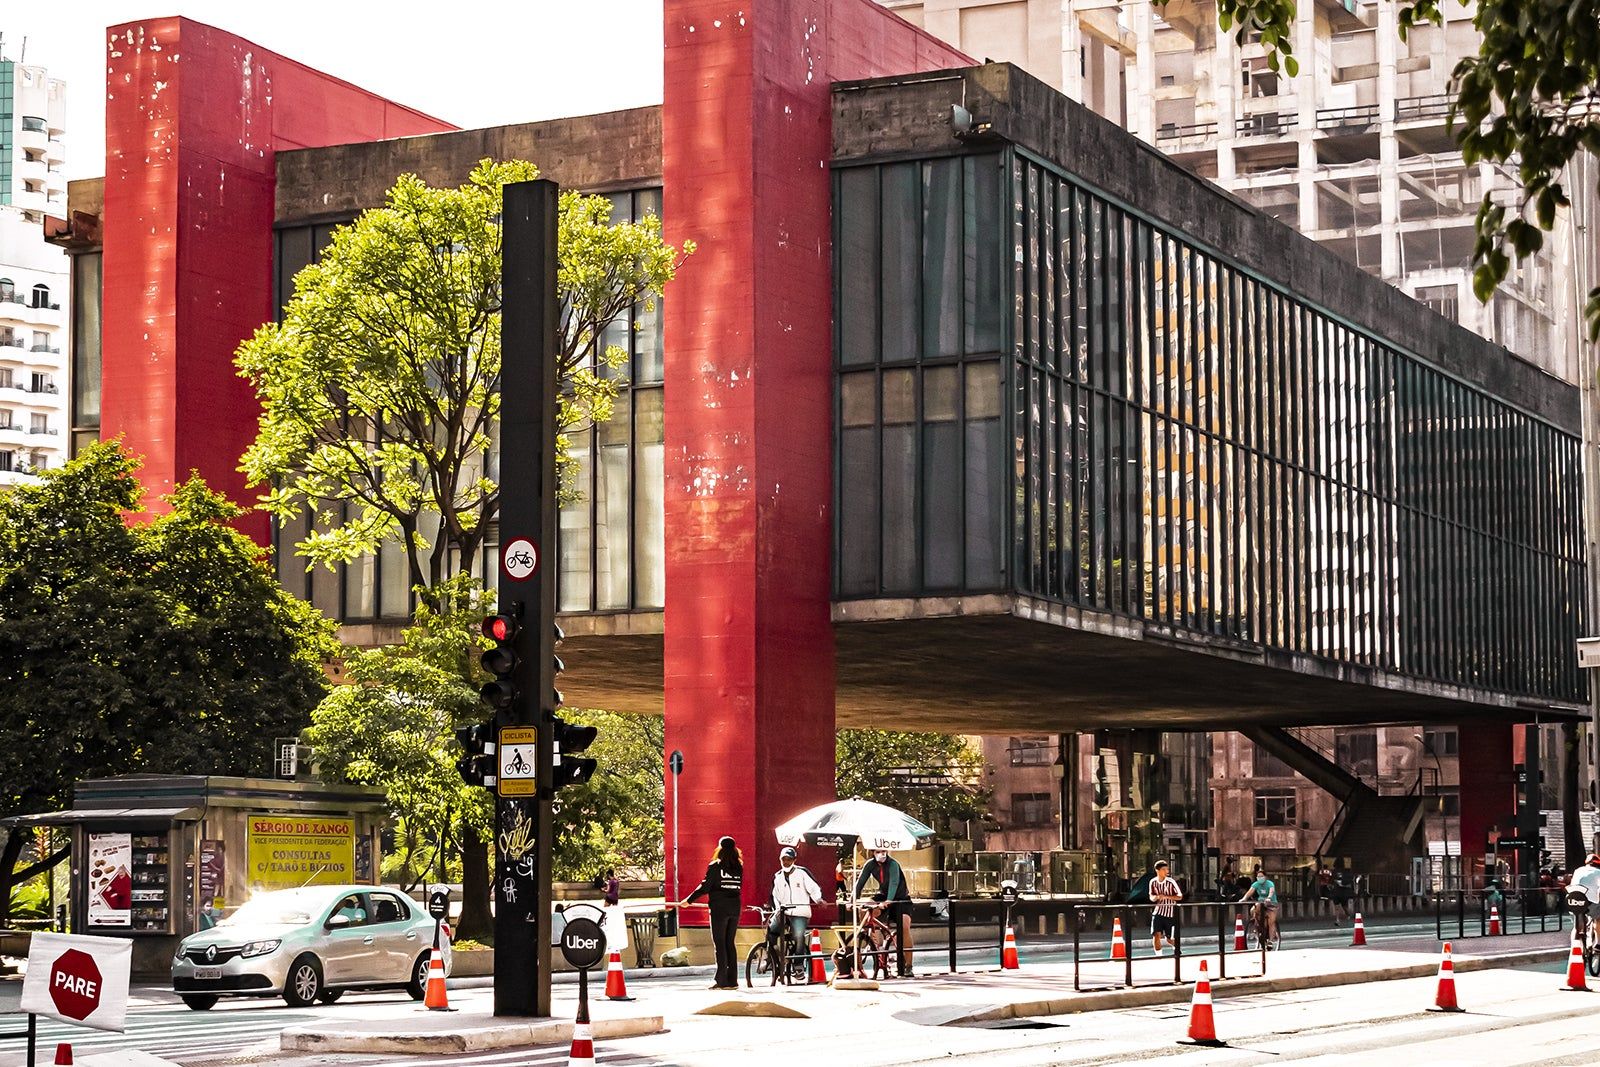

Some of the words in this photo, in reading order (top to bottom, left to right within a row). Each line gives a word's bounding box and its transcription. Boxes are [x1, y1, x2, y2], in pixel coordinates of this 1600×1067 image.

[504, 732, 532, 740] CICLISTA
[254, 820, 293, 833] SÉRGIO
[296, 823, 310, 833] DE
[314, 838, 347, 846] FEDERAÇÃO
[874, 838, 901, 849] Uber
[273, 850, 331, 860] CONSULTAS
[257, 863, 269, 873] C/
[301, 863, 308, 871] E
[309, 861, 345, 872] BÚZIOS
[1567, 898, 1586, 906] Uber
[566, 935, 599, 949] Uber
[55, 970, 97, 999] PARE
